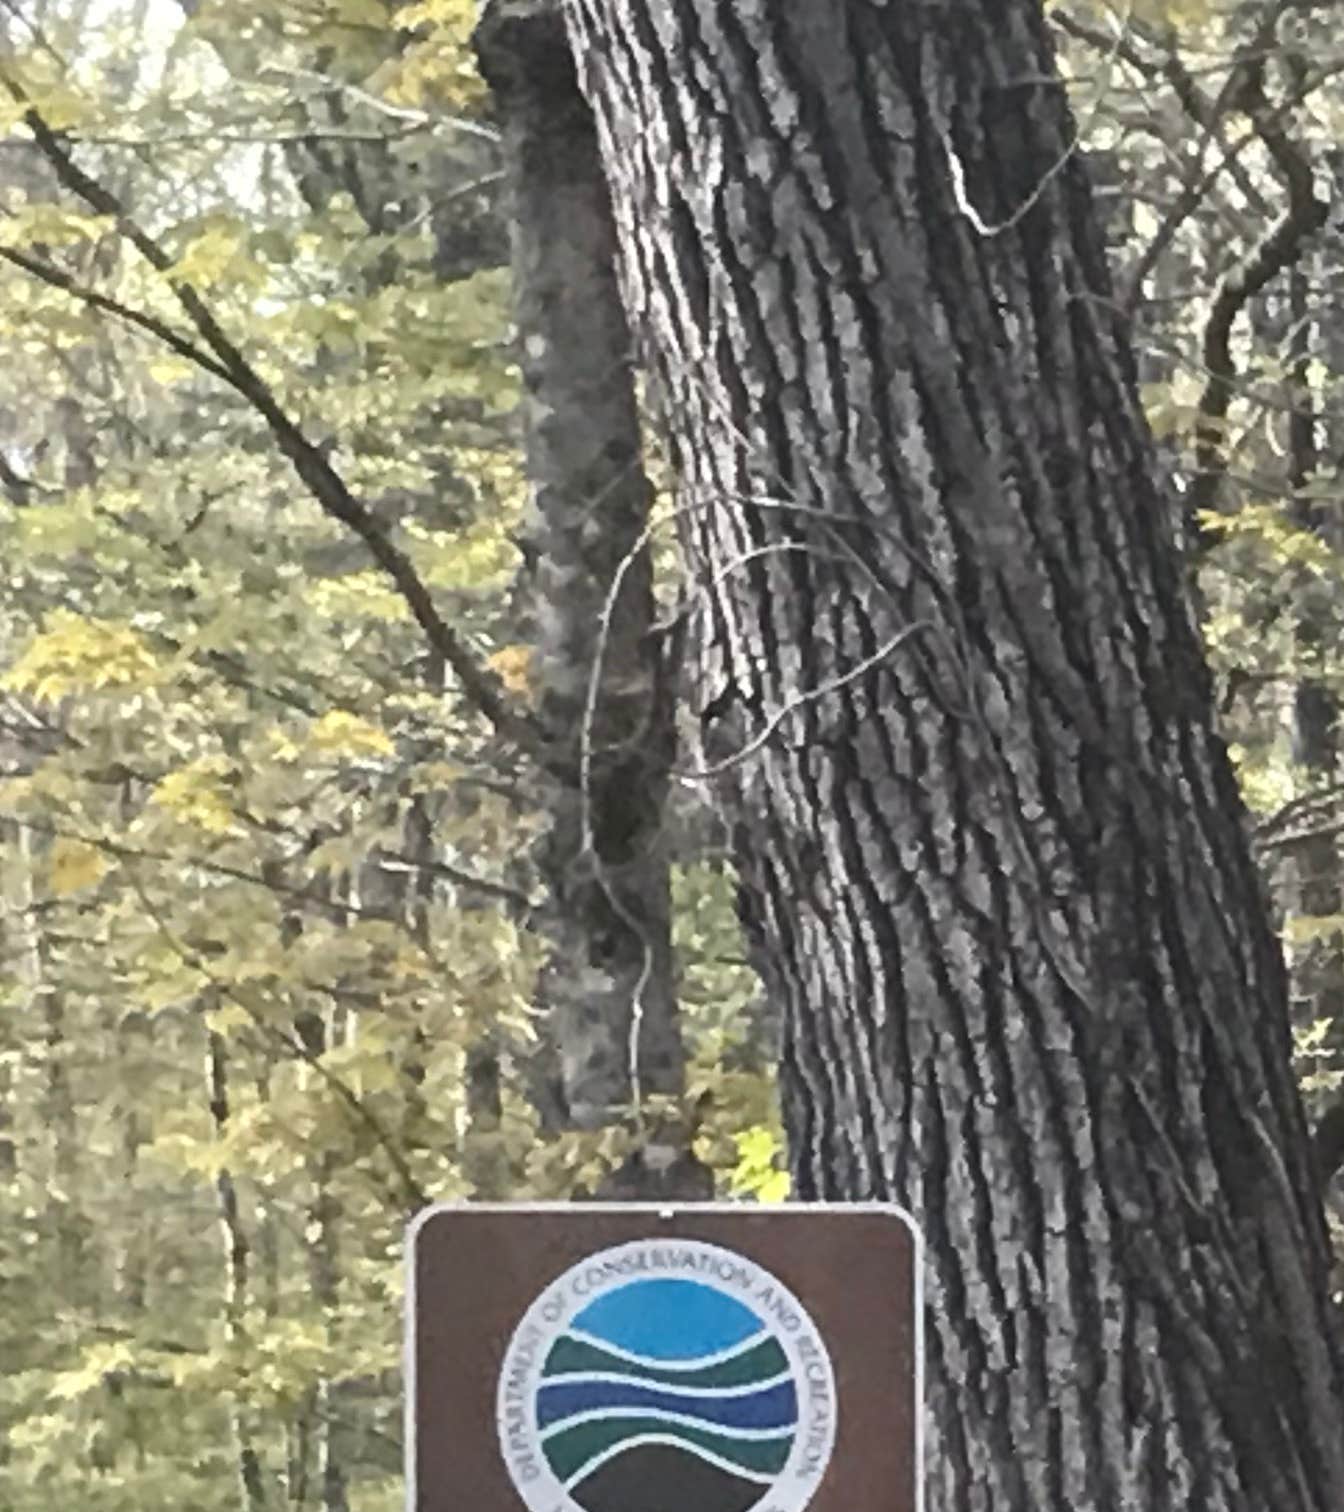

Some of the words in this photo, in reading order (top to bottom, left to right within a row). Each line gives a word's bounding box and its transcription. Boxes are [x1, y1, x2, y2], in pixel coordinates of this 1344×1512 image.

[506, 1323, 546, 1484] DEPARTMENT
[536, 1291, 569, 1325] OF
[566, 1248, 756, 1298] CONSERVATION
[755, 1282, 805, 1336] AND
[792, 1332, 828, 1484] RECREATION
